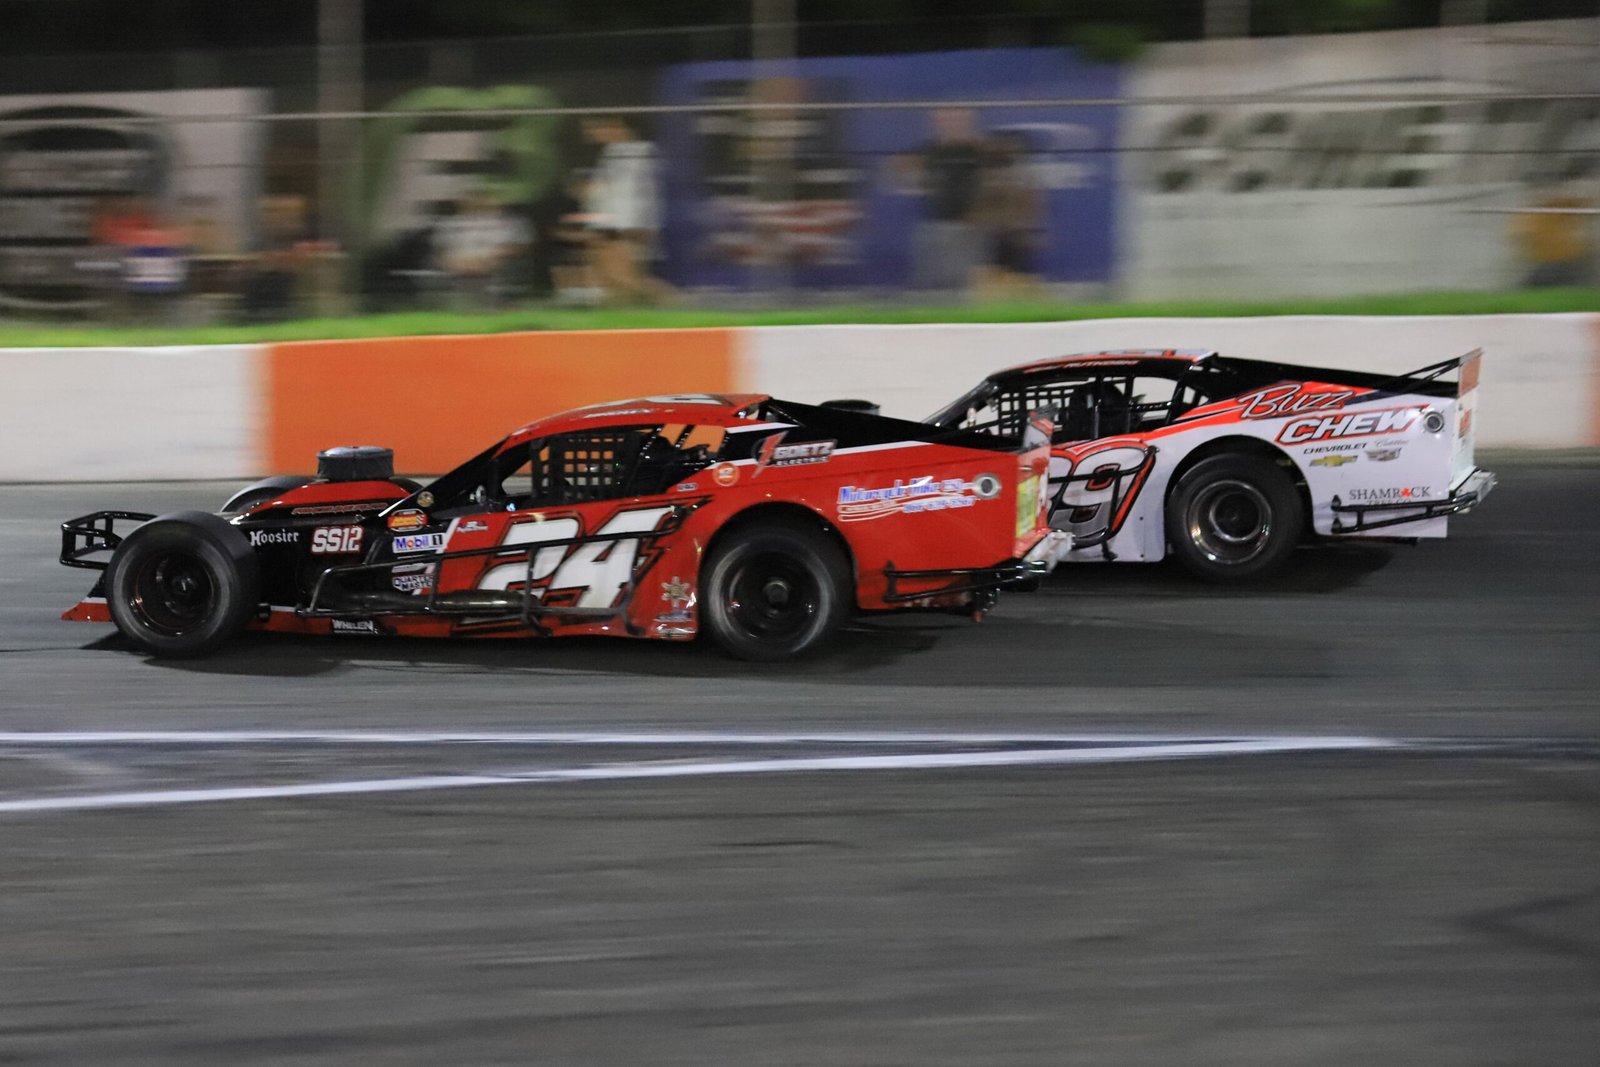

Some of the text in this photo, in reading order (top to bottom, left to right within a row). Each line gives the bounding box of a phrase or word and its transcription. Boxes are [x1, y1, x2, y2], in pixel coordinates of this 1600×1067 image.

[1238, 384, 1353, 419] Buzz
[1275, 405, 1424, 446] CHEW
[1303, 442, 1367, 454] CHEVROLET
[250, 528, 299, 547] Hoosier
[311, 527, 363, 553] SS12
[395, 536, 429, 550] Mobil
[474, 503, 688, 610] 24
